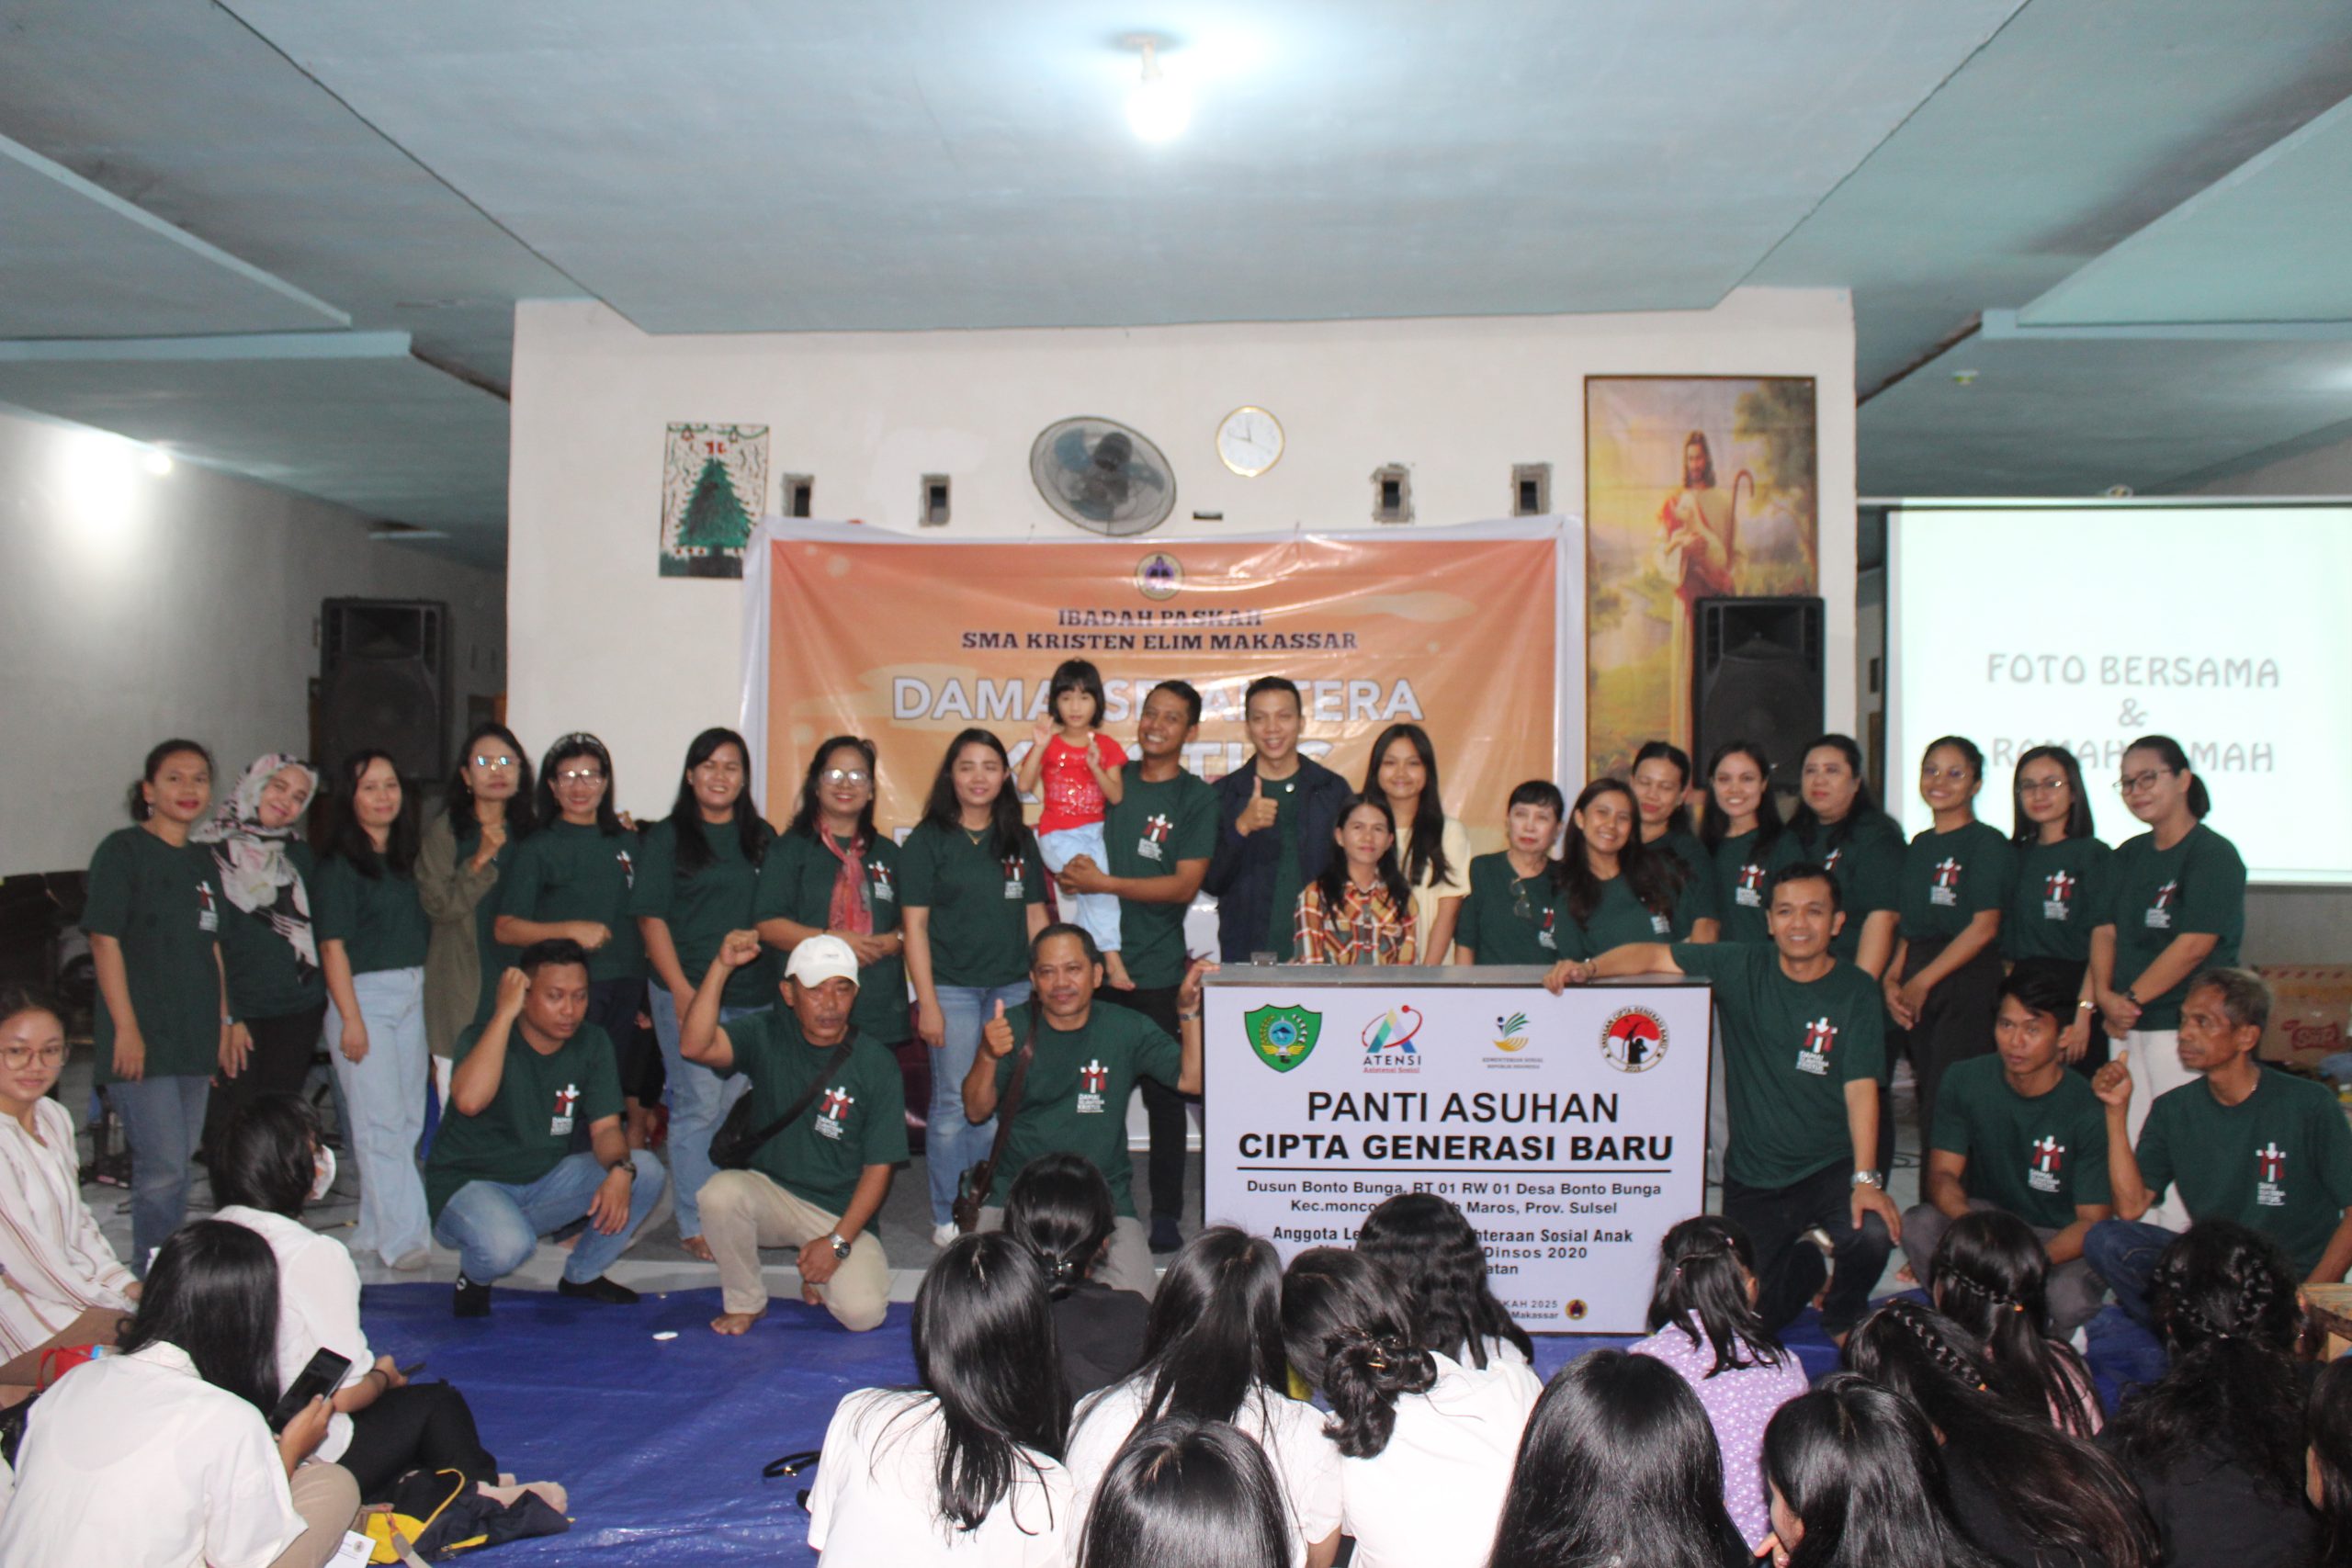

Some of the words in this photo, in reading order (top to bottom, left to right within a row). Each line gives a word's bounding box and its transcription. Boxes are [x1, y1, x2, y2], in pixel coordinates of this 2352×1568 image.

[1058, 609, 1153, 627] IBADAH
[1159, 609, 1262, 627] PASKAH
[962, 632, 1018, 649] SMA
[1026, 632, 1136, 650] KRISTEN
[1143, 633, 1203, 650] ELIM
[1210, 633, 1358, 650] MAKASSAR
[1986, 652, 2086, 684] FOTO
[2100, 656, 2280, 687] BERSAMA
[2118, 697, 2148, 728] &
[1363, 1055, 1421, 1066] ATENSI
[1308, 1091, 1427, 1122] PANTI
[1440, 1092, 1618, 1122] ASUHAN
[1238, 1133, 1350, 1159] CIPTA
[1363, 1134, 1555, 1160] GENERASI
[1570, 1135, 1672, 1160] BARU
[1248, 1180, 1296, 1192] Dusun
[1302, 1181, 1348, 1193] Bonto
[1413, 1182, 1433, 1193] RT
[1439, 1182, 1455, 1193] 01
[1463, 1183, 1487, 1194] RW
[1493, 1183, 1510, 1194] 01
[1517, 1183, 1555, 1194] Desa
[1561, 1183, 1606, 1195] Bonto
[1612, 1183, 1661, 1197] Bunga
[1467, 1202, 1520, 1215] Maros,
[1526, 1202, 1564, 1213] Prov.
[1569, 1202, 1618, 1213] Sulsel
[1273, 1226, 1338, 1242] Anggota
[1541, 1229, 1588, 1243] Sosial
[1594, 1229, 1633, 1243] Anak
[1484, 1247, 1542, 1258] Dinsos
[1547, 1247, 1588, 1258] 2020
[1531, 1300, 1558, 1308] 2025
